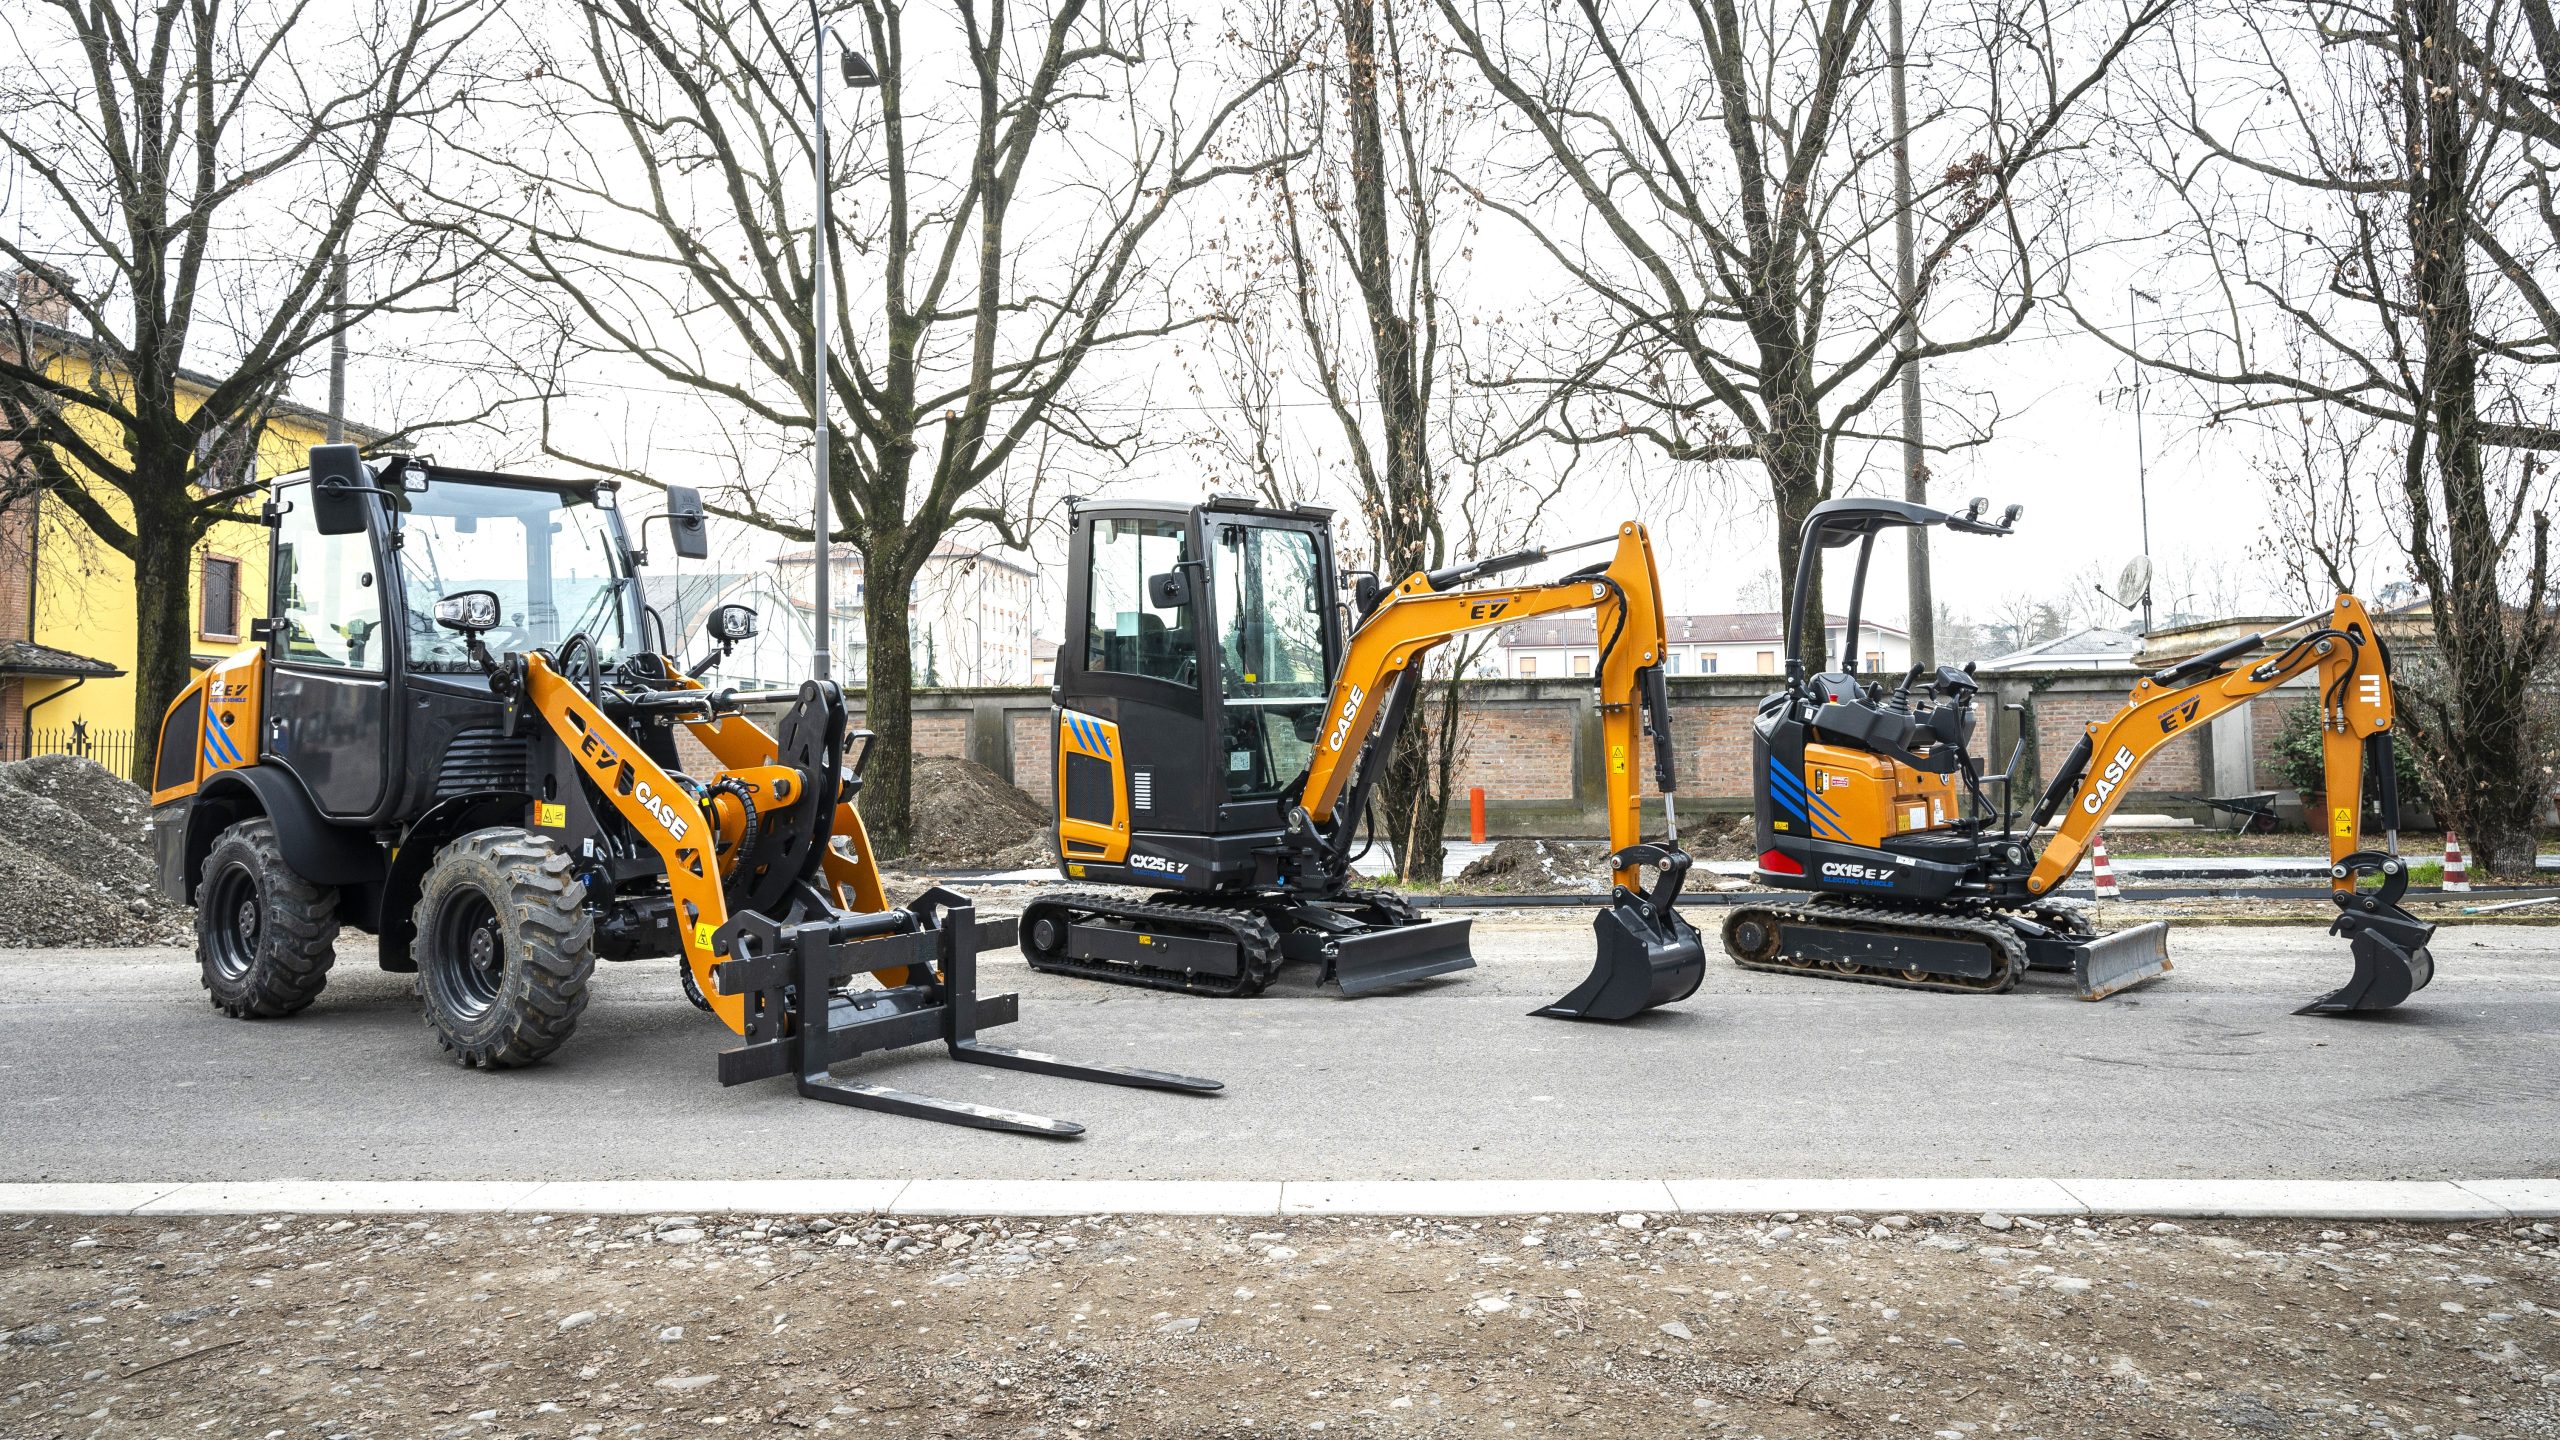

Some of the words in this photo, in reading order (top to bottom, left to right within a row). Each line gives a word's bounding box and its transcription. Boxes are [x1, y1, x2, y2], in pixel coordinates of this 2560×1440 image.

[1471, 603, 1509, 620] EV
[1329, 683, 1364, 752] CASE
[2160, 699, 2200, 733] EV
[2083, 744, 2136, 814] CASE
[635, 781, 689, 842] CASE
[1823, 876, 1859, 885] ELECTRIC
[1860, 879, 1895, 888] VEHICLE
